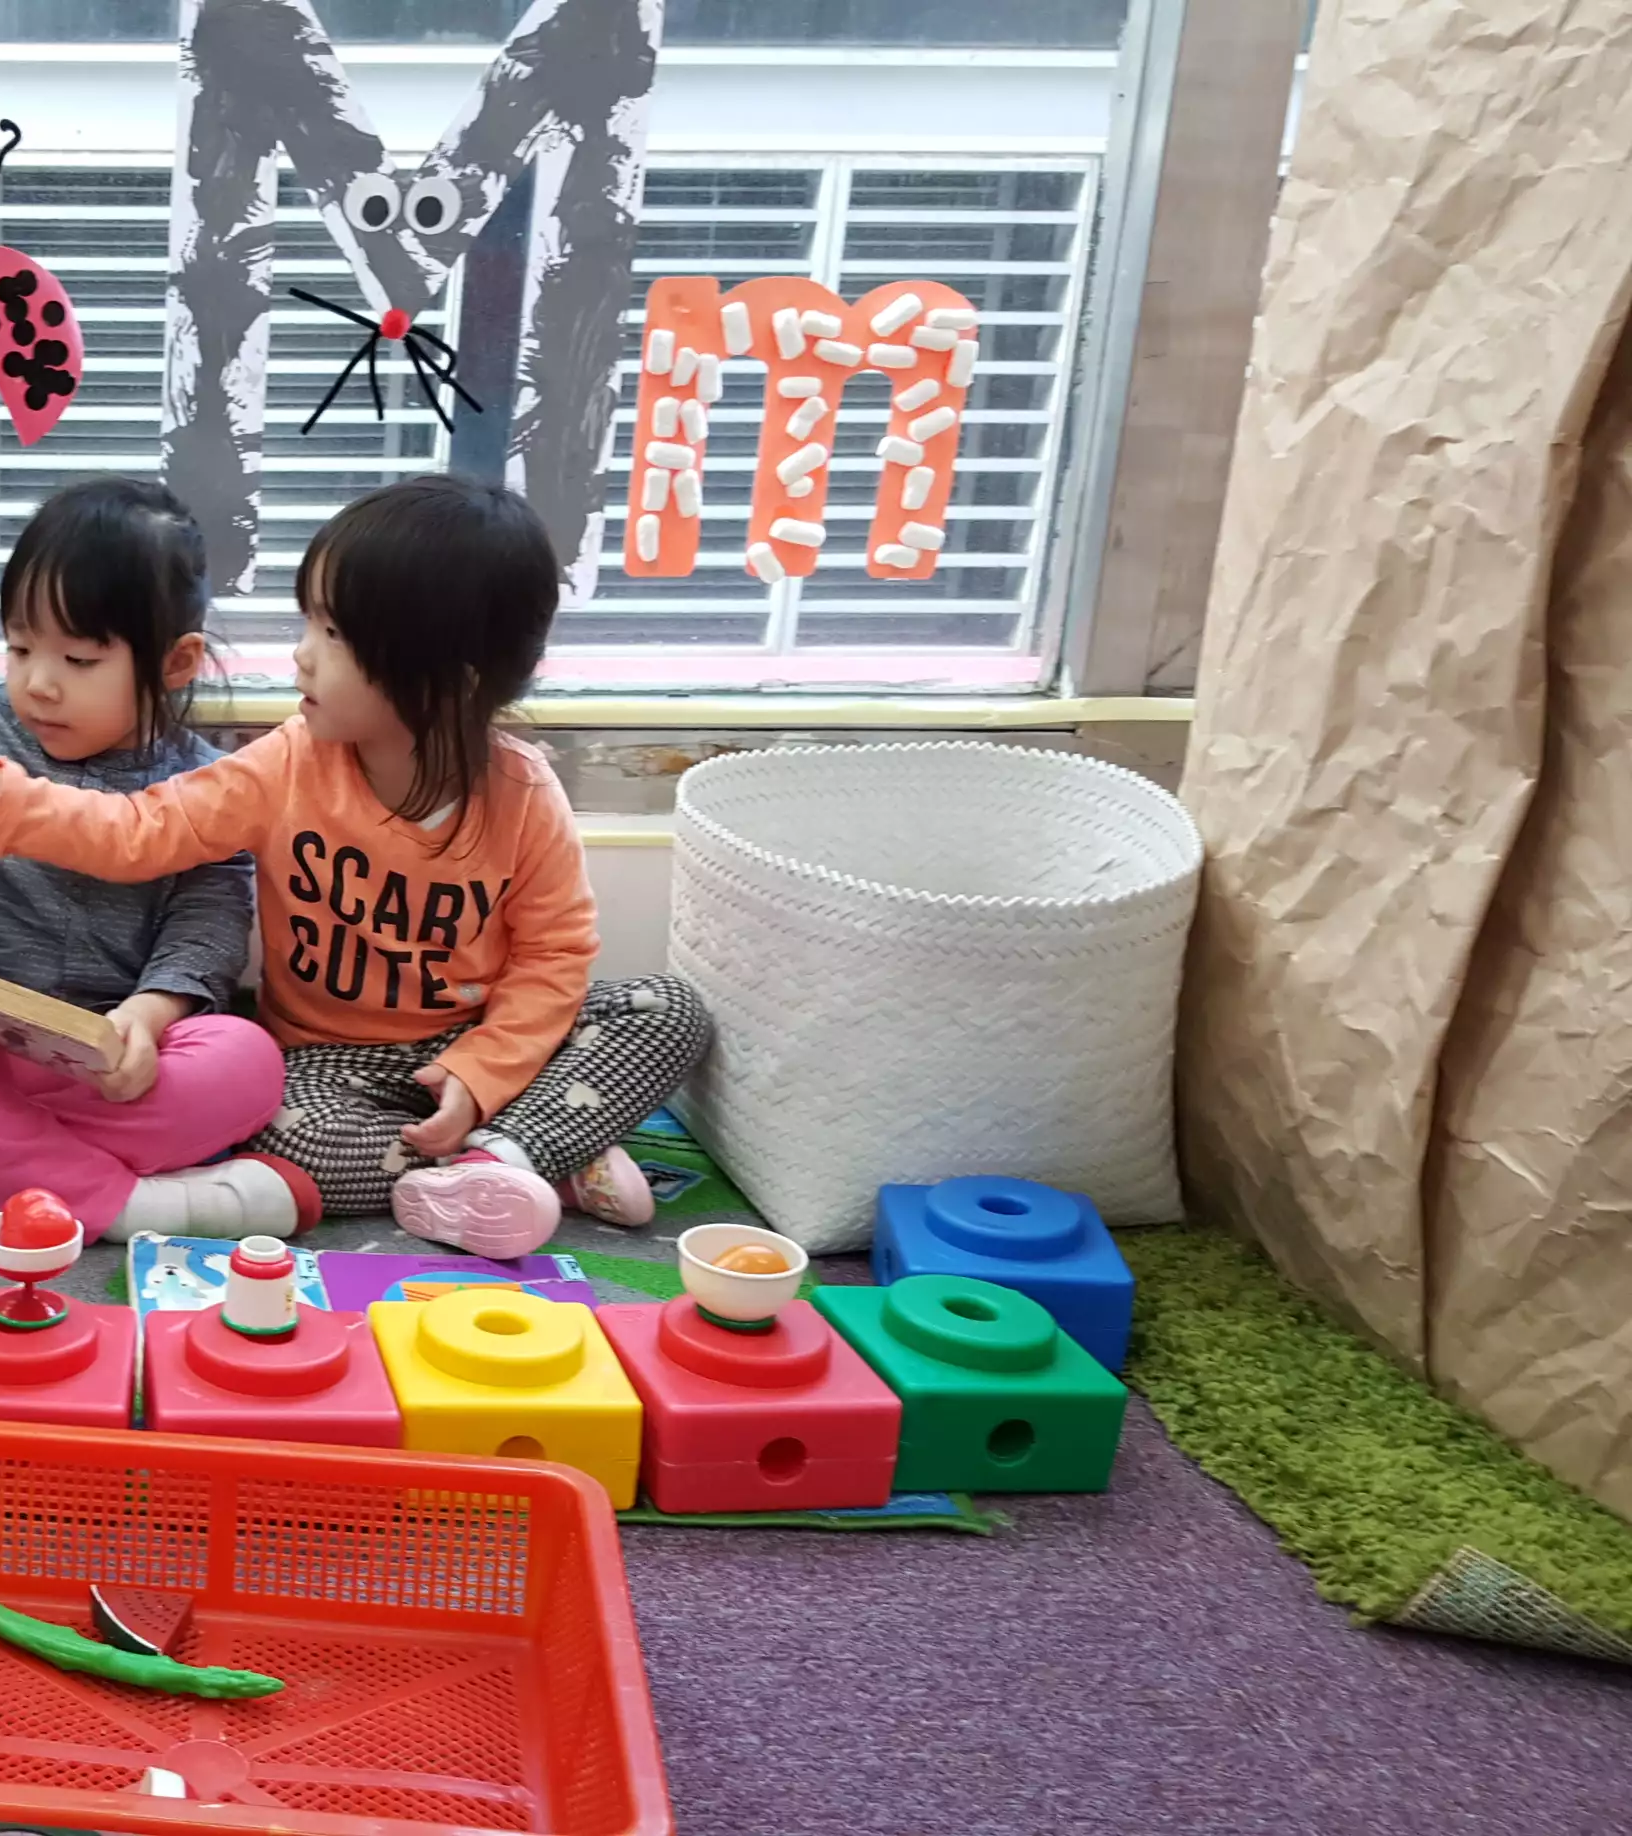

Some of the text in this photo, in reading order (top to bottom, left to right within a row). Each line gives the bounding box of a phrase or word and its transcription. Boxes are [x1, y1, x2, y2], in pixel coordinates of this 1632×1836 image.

[160, 0, 665, 608] M
[624, 276, 978, 582] m
[289, 830, 512, 950] SCARY
[289, 914, 457, 1010] CUTE
